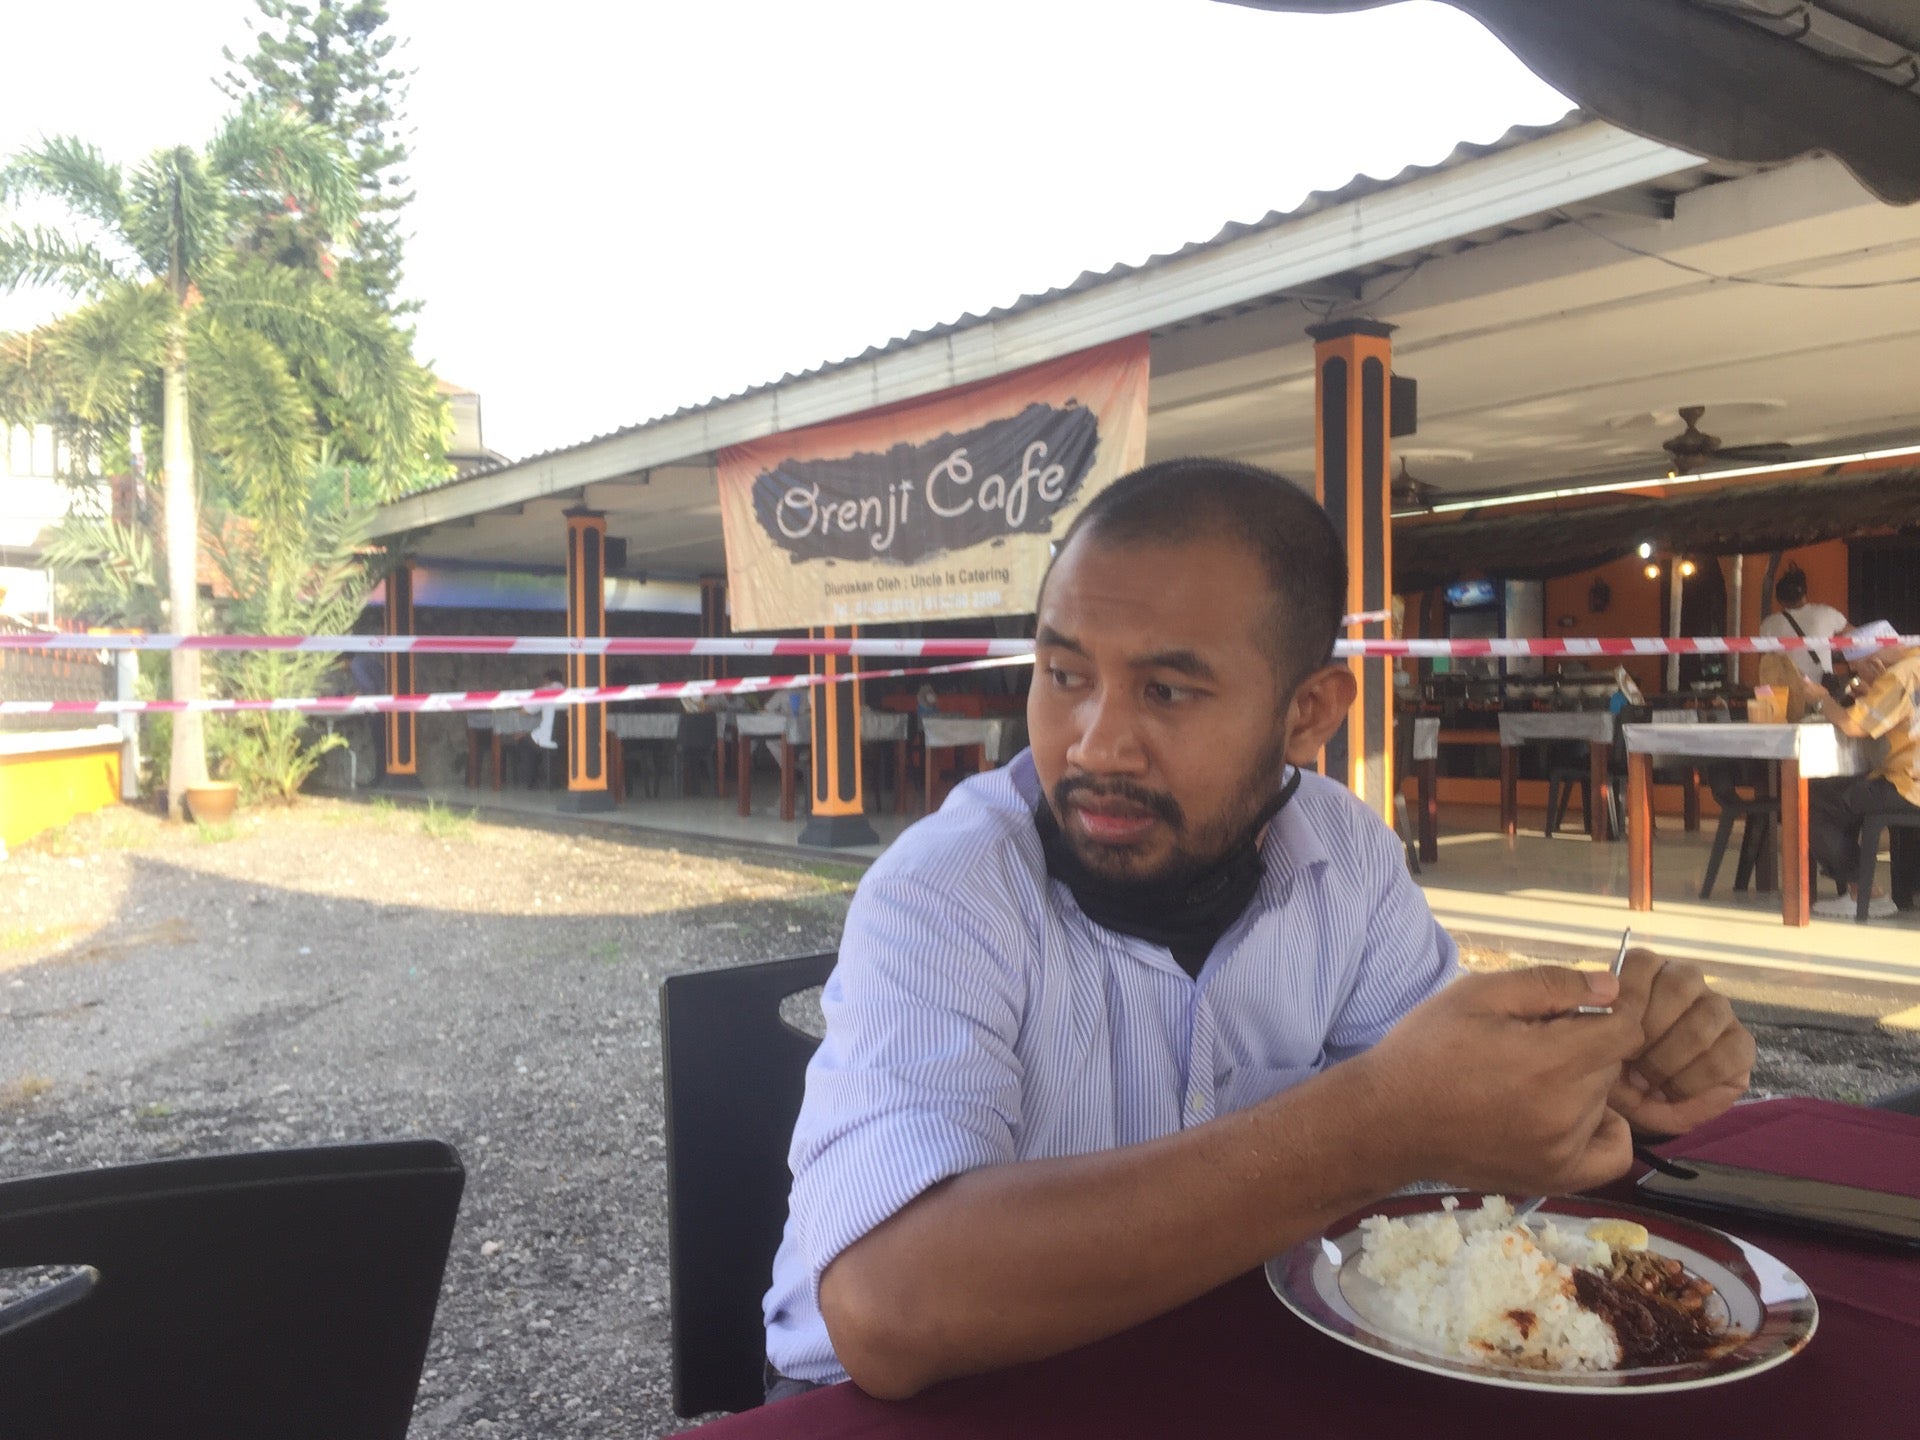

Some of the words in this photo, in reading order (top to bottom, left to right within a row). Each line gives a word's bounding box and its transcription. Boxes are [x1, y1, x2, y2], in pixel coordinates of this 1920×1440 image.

[776, 478, 915, 551] Orenji
[926, 440, 1065, 528] Cafe
[876, 576, 901, 592] Oleh
[911, 572, 942, 588] Uncle
[945, 570, 955, 585] Is
[958, 565, 1010, 584] Catering
